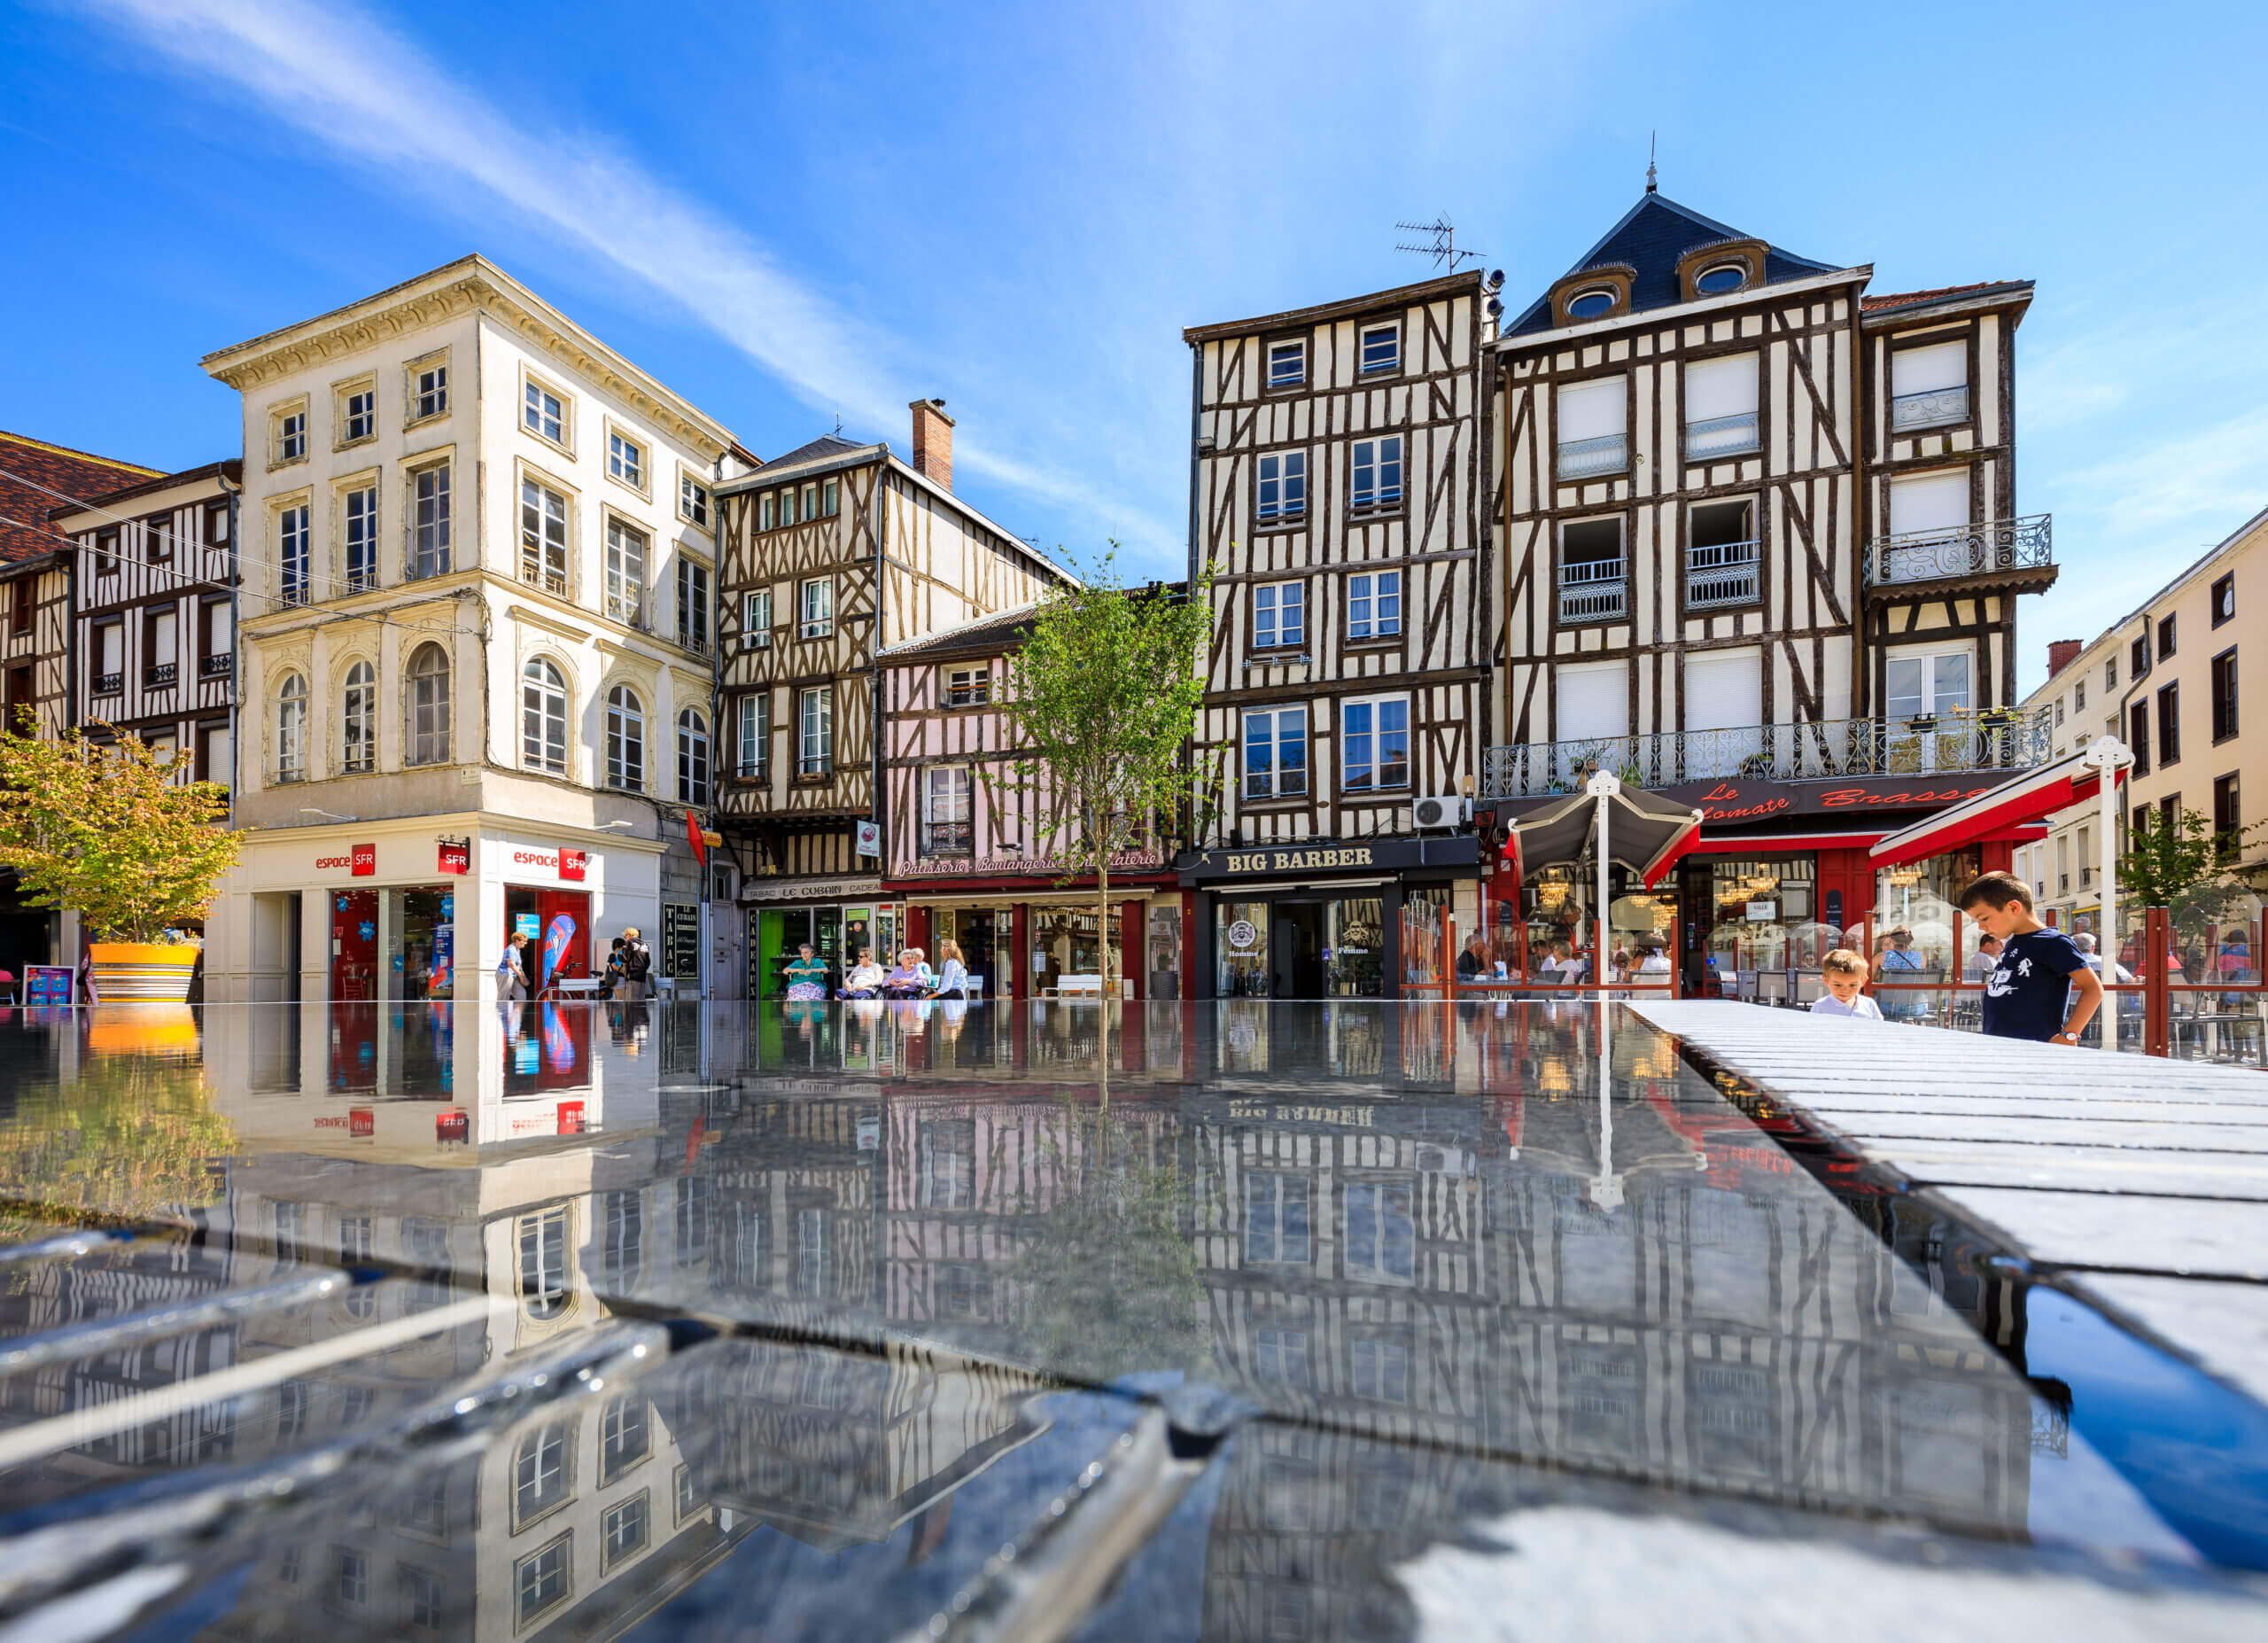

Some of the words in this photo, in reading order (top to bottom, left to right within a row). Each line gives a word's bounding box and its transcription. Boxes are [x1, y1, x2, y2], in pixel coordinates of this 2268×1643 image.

[1701, 783, 1738, 801] Le
[1821, 787, 1988, 807] Brasse
[1702, 797, 1790, 821] lomate
[315, 856, 351, 869] espace
[355, 853, 373, 866] SFR
[446, 853, 466, 866] SFR
[513, 849, 558, 868] espace
[566, 857, 586, 871] SFR
[1070, 850, 1156, 871] Choaterie
[1227, 854, 1268, 872] BIG
[1274, 848, 1372, 869] BARBER
[750, 890, 775, 899] TABAC
[782, 888, 796, 897] LE
[849, 884, 880, 892] CADEA
[665, 907, 674, 973] TABAC
[1339, 946, 1369, 955] Femme
